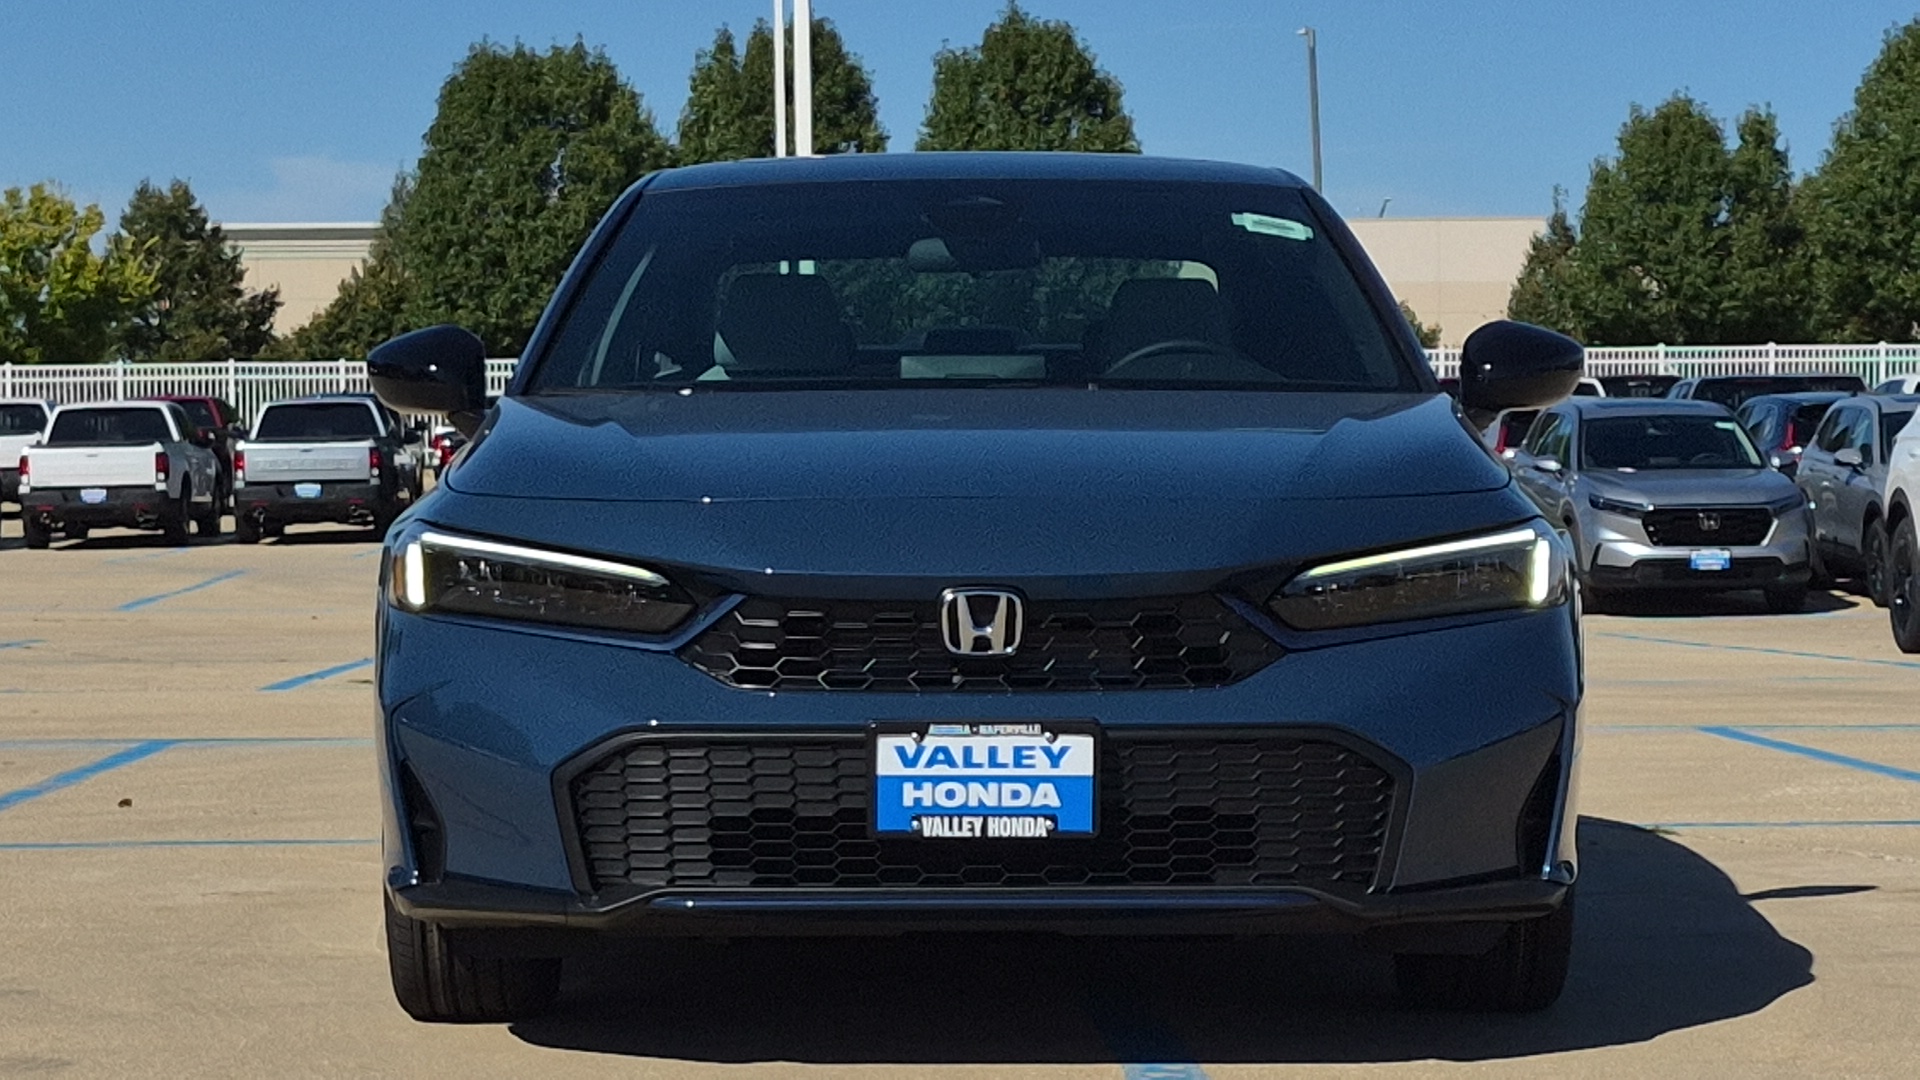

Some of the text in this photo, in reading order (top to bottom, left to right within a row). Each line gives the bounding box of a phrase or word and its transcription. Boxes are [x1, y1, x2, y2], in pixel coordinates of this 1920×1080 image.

[894, 745, 1071, 769] VALLEY
[902, 782, 1061, 807] HONDA
[921, 816, 1048, 837] VALLEY HONDA
